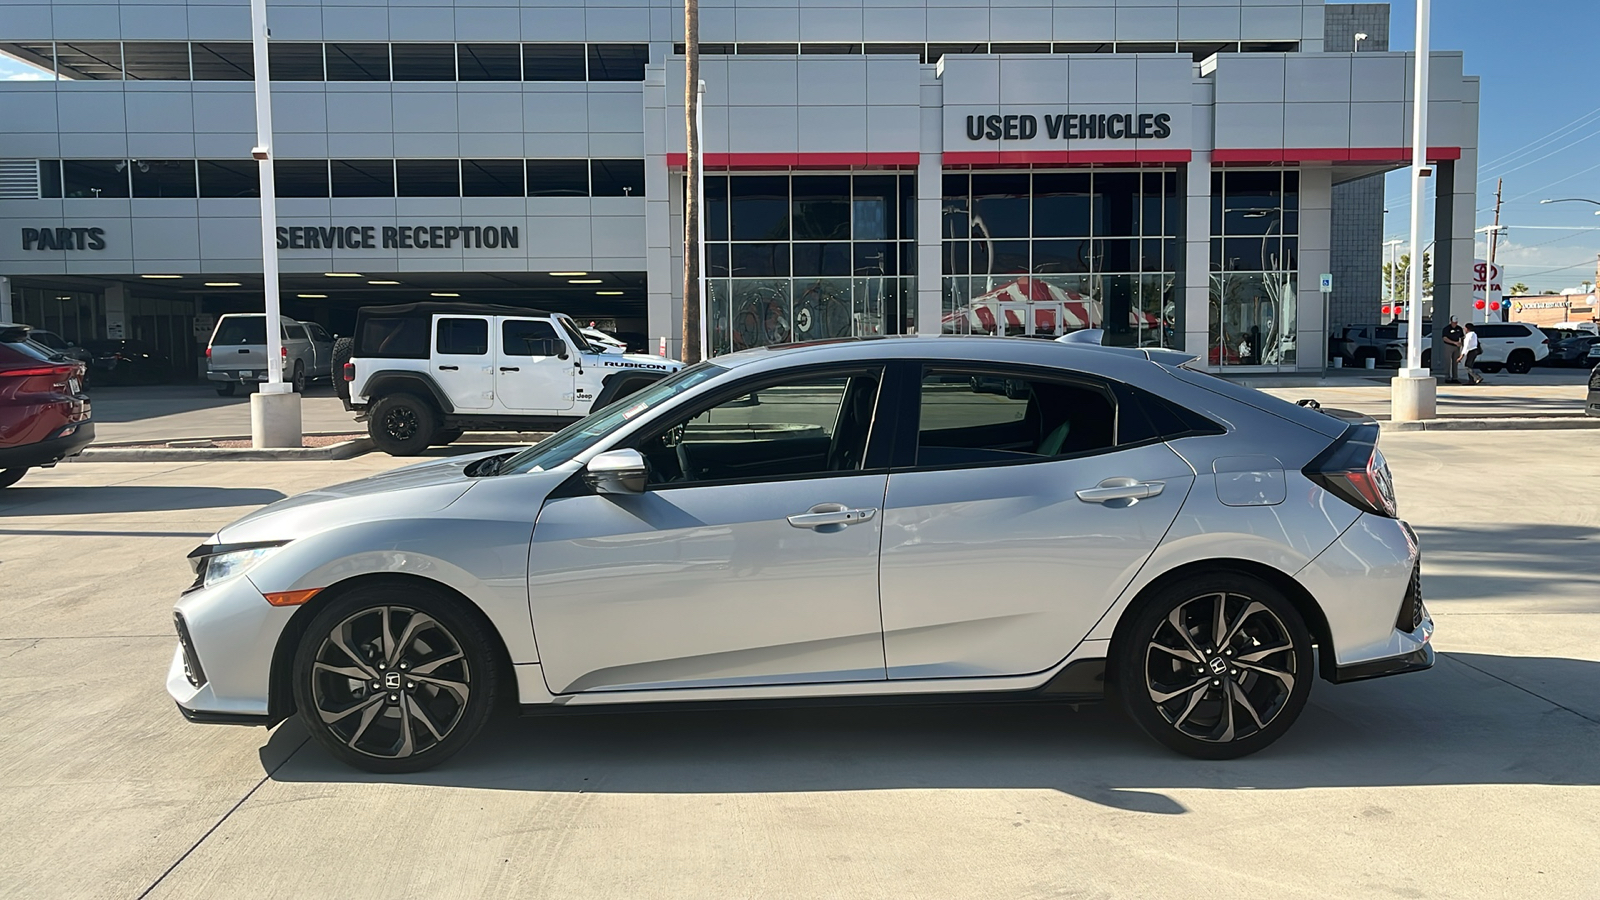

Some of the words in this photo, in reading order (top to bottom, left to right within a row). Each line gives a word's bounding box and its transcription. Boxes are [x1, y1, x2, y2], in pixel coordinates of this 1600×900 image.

[966, 115, 1037, 141] USED
[1044, 113, 1171, 140] VEHICLES
[21, 227, 106, 251] PARTS
[276, 226, 376, 249] SERVICE
[382, 225, 519, 249] RECEPTION
[1473, 283, 1502, 292] YOTA
[604, 361, 667, 370] RUBICON
